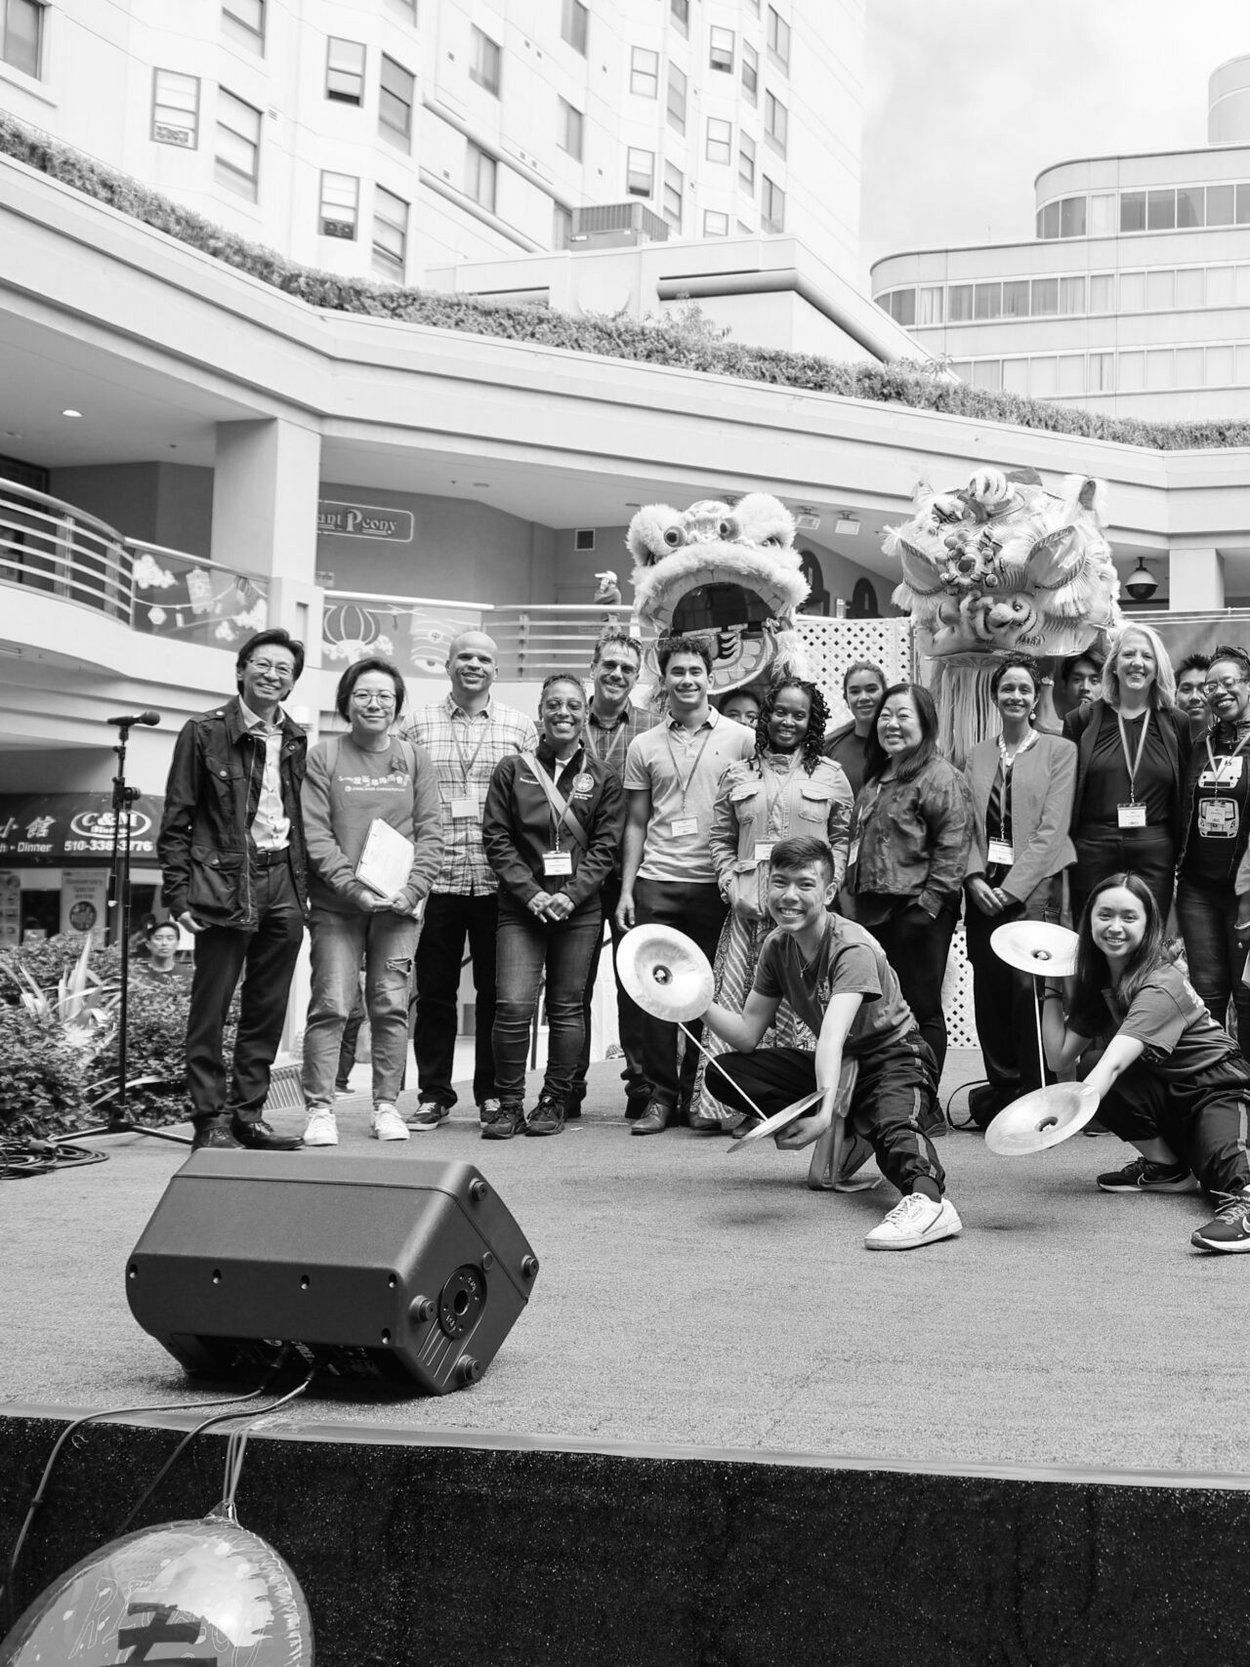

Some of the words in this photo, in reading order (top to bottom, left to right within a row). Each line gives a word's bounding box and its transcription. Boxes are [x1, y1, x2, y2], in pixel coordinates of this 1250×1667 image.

[346, 509, 397, 534] Peony
[81, 812, 138, 827] C&M
[17, 842, 53, 853] Dinner
